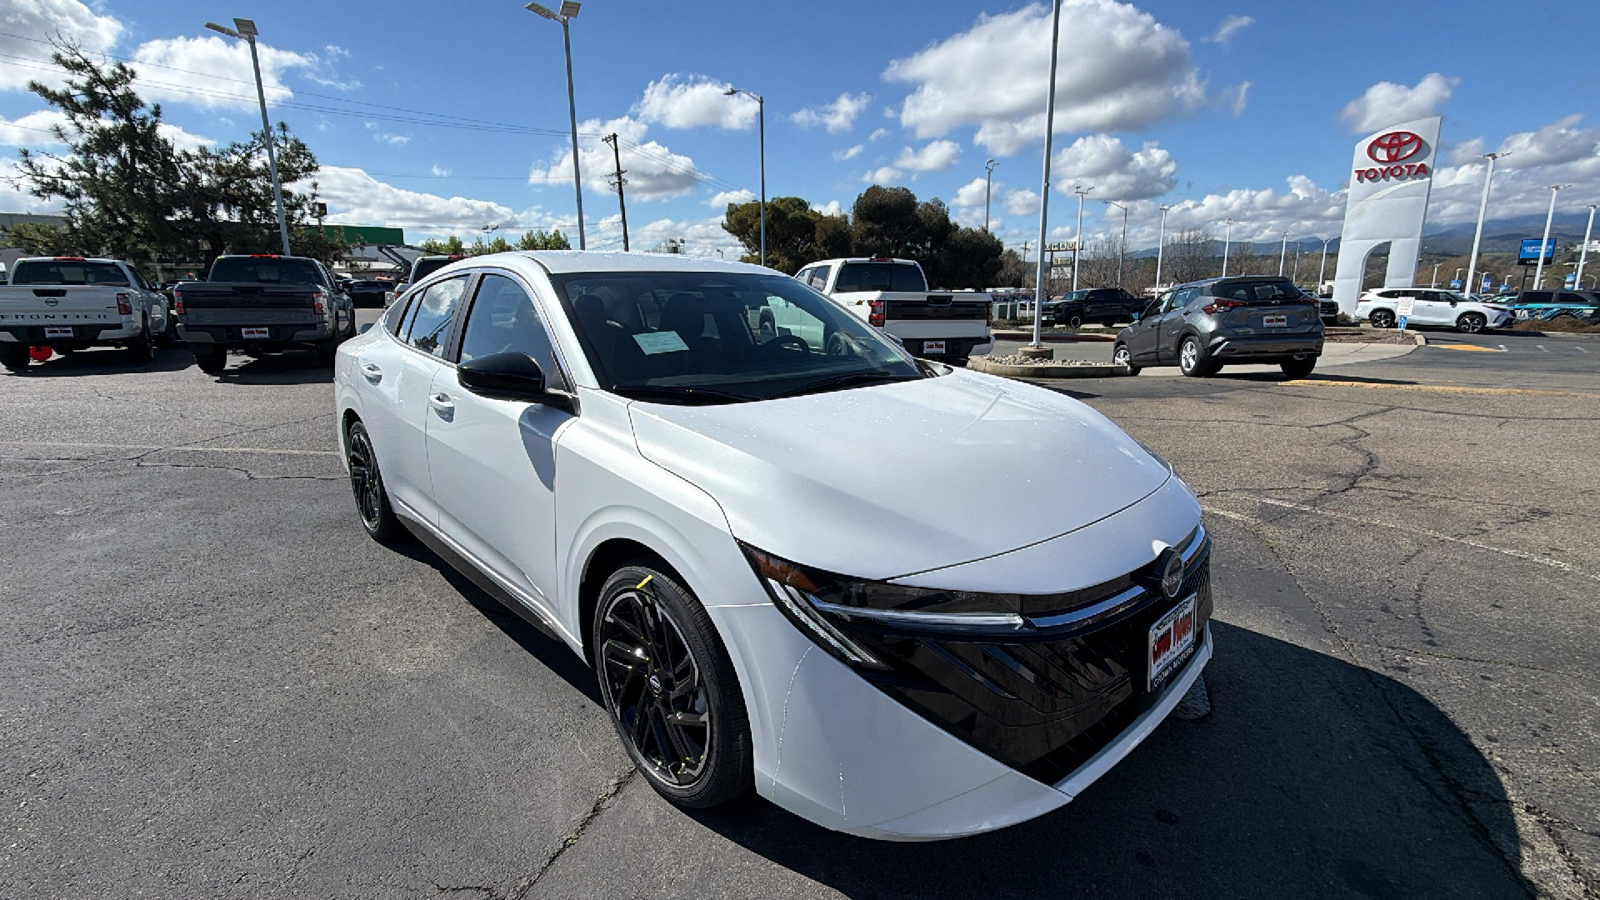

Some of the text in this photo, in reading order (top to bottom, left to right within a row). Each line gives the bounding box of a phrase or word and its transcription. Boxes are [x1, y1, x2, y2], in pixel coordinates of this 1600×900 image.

[1354, 162, 1428, 181] TOYOTA
[1153, 664, 1173, 688] CROWN
[1173, 644, 1194, 669] MOTORS
